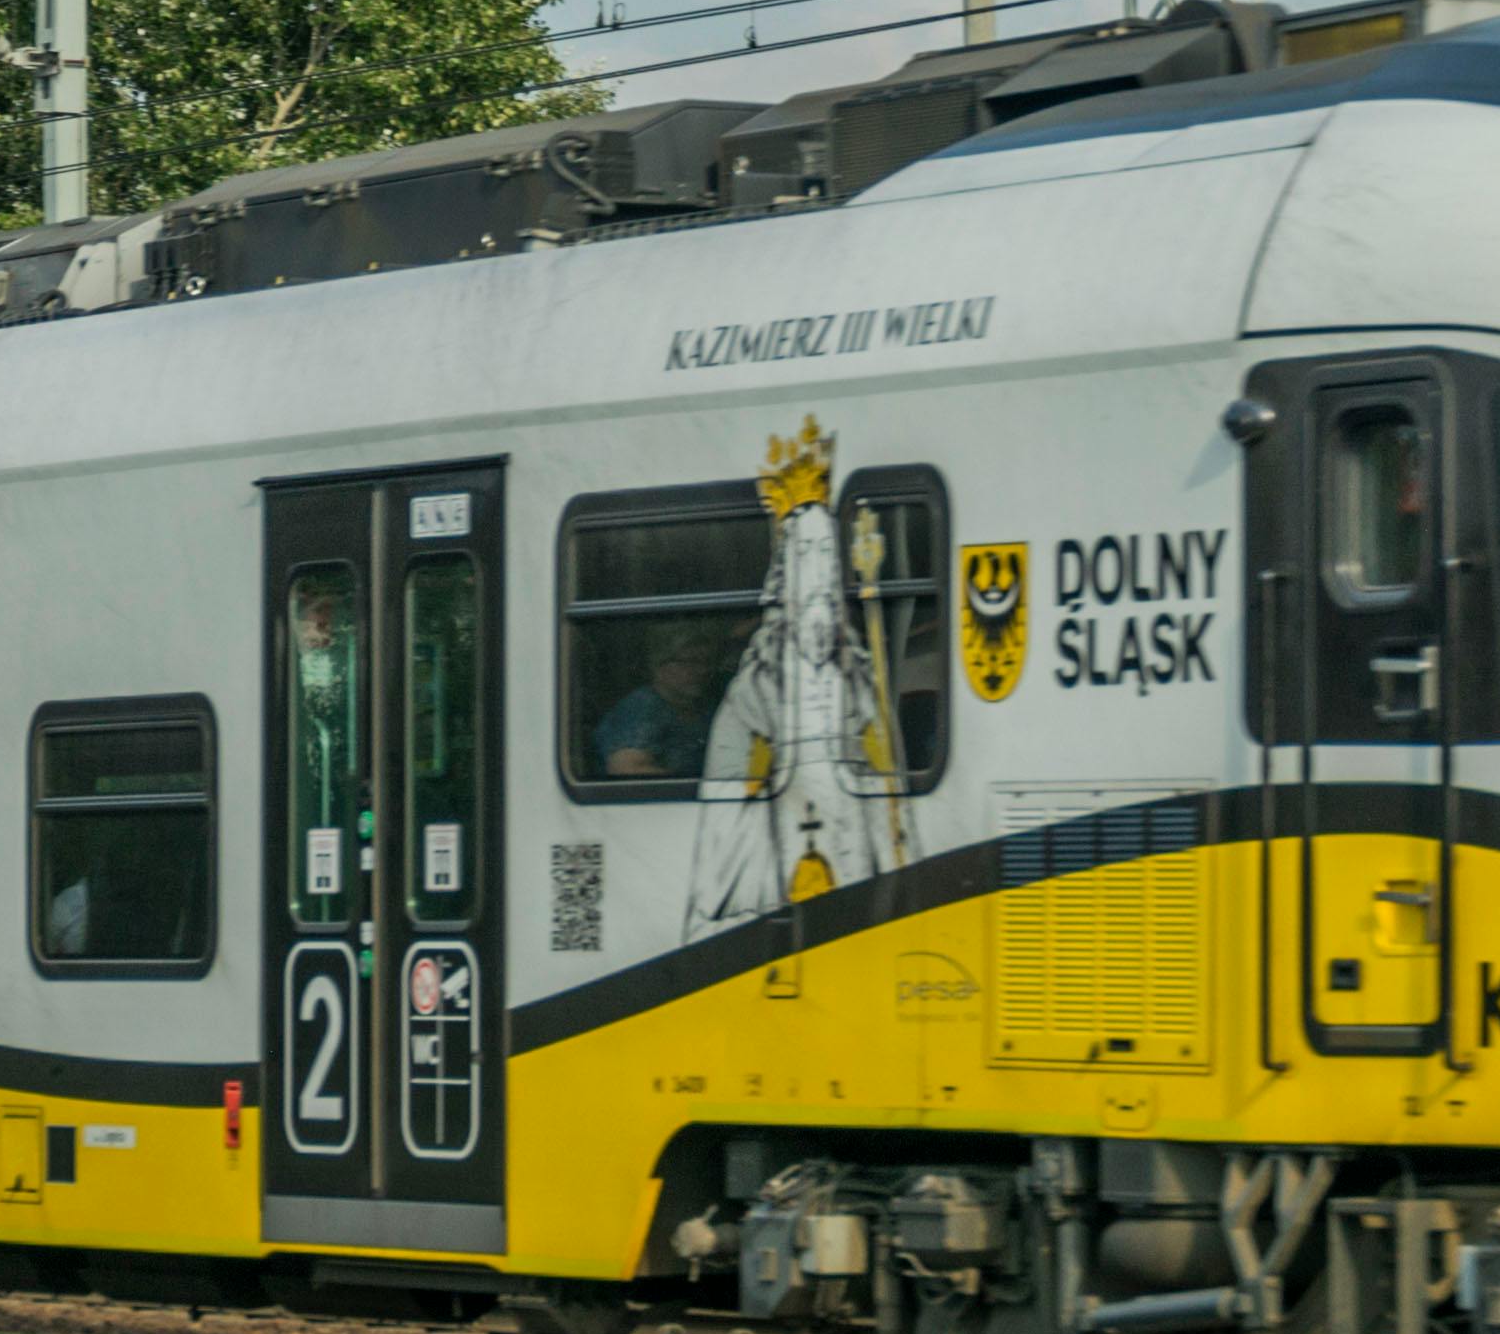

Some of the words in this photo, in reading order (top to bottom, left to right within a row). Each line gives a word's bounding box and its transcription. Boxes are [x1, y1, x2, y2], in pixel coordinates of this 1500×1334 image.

[663, 314, 838, 372] KAZIMIERZ
[836, 309, 879, 355] III
[883, 295, 997, 347] WIELKI
[1054, 528, 1229, 606] DOLNY
[1054, 601, 1217, 698] ŚLĄSK
[299, 975, 343, 1121] 2
[410, 1034, 441, 1065] WC
